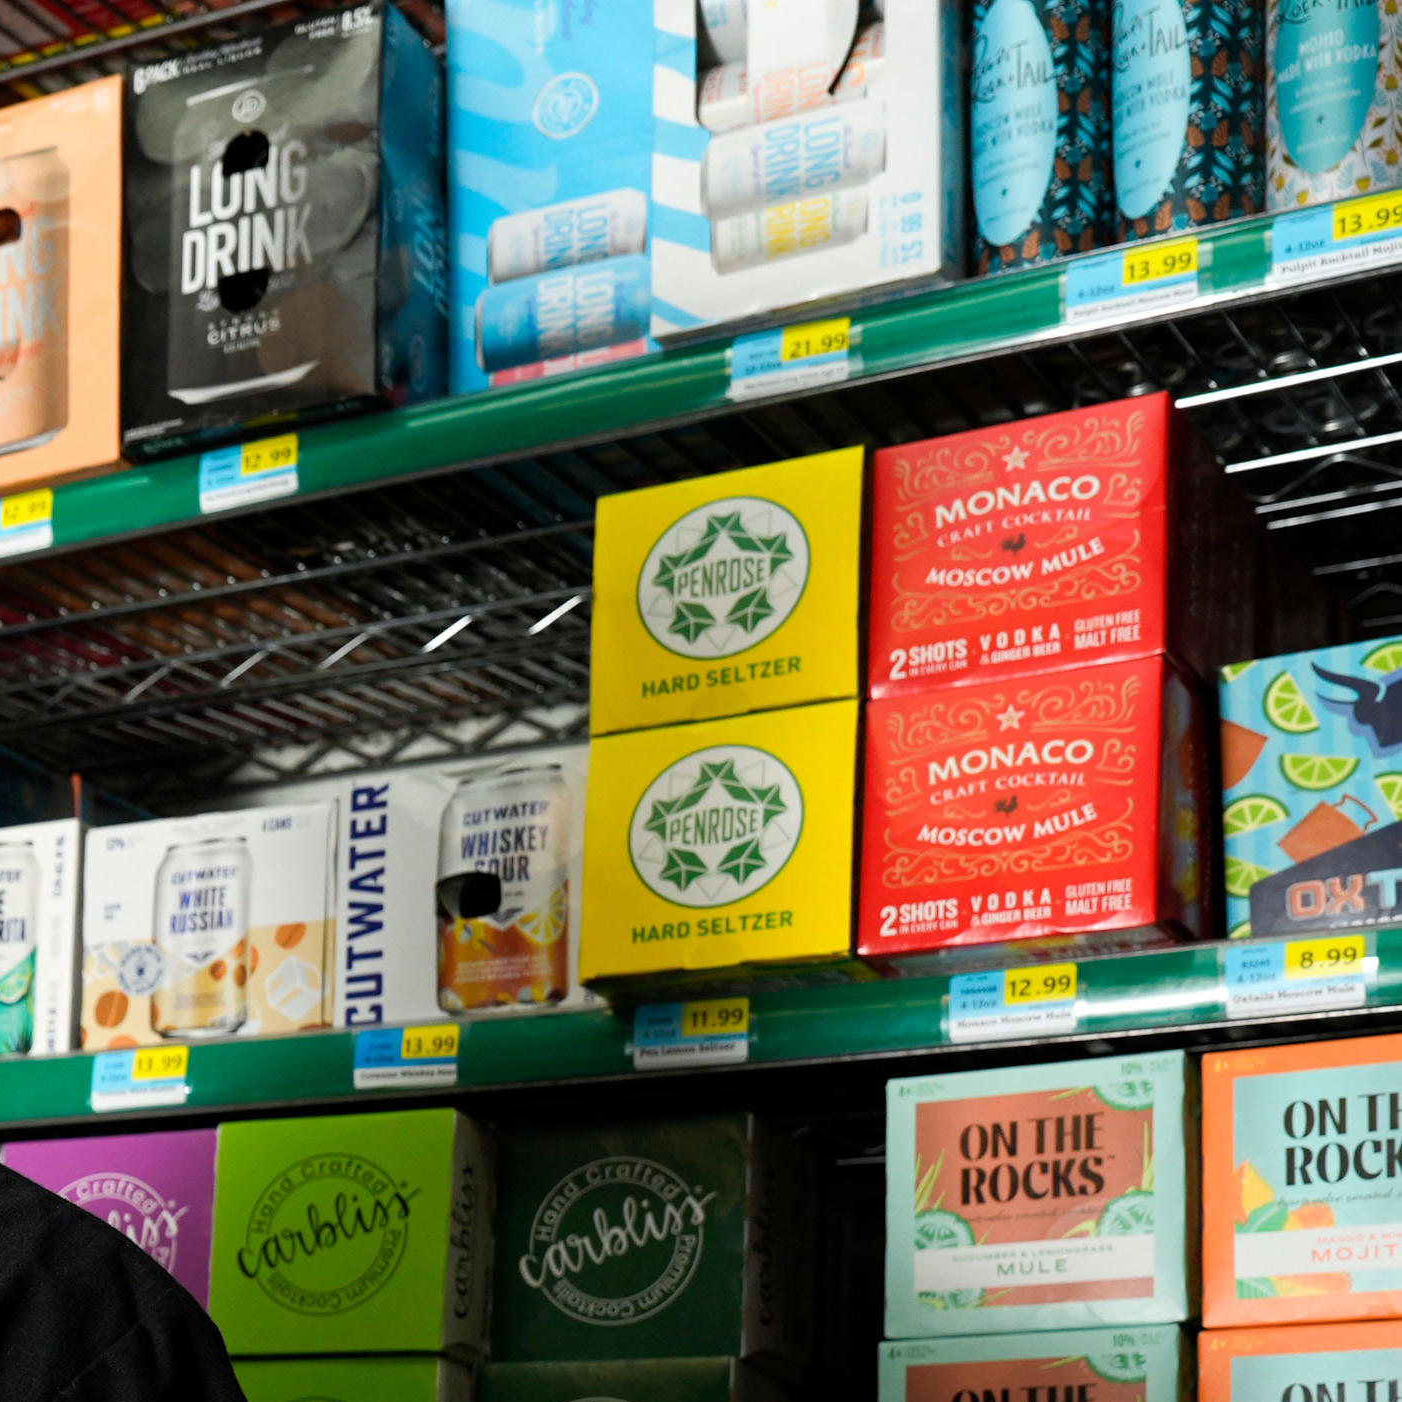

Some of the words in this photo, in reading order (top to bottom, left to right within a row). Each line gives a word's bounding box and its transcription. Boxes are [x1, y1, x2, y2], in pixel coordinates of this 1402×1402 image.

[806, 116, 843, 190] LONG
[182, 206, 312, 294] DRINK
[1129, 252, 1191, 276] 13.99
[208, 316, 281, 346] CITRUS
[791, 333, 846, 359] 21.99
[933, 474, 1100, 529] MONACO
[937, 522, 994, 549] CRAFT
[1002, 506, 1092, 529] COCKTAIL
[677, 554, 766, 599] PENROSE
[926, 564, 1032, 588] MOSCOW
[1041, 537, 1105, 573] MULE
[1074, 615, 1110, 633] GLUTEN
[1113, 609, 1140, 625] FREE
[1074, 631, 1109, 649] MALT
[1111, 623, 1140, 643] FREE
[642, 675, 700, 699] HARD
[706, 656, 802, 684] SELTZER
[889, 650, 908, 679] 2
[909, 638, 967, 665] SHOTS
[927, 739, 1093, 787] MONACO
[931, 782, 987, 805] CRAFT
[995, 769, 1087, 789] COCKTAIL
[461, 825, 548, 860] WHISKEY
[667, 805, 759, 844] PENROSE
[917, 822, 1022, 847] MOSCOW
[1033, 802, 1098, 838] MULE
[179, 886, 226, 910] WHITE
[346, 783, 391, 1025] CUTWATER
[880, 908, 897, 936] 2
[900, 899, 957, 923] SHOTS
[170, 908, 234, 935] RUSSIAN
[632, 922, 690, 944] HARD
[696, 910, 793, 933] SELTZER
[1301, 947, 1358, 968] 8.99
[1010, 977, 1071, 998] 12.99
[690, 1010, 745, 1029] 11.99
[406, 1035, 454, 1053] 13.99
[960, 1121, 1018, 1163] ON
[1028, 1112, 1105, 1154] THE
[1284, 1097, 1346, 1140] ON
[254, 1176, 296, 1235] Hand
[300, 1156, 390, 1195] Crafted
[534, 1179, 578, 1242] Hand
[587, 1161, 682, 1200] Crafted
[961, 1156, 1105, 1206] ROCKS
[238, 1181, 421, 1279] carbliss
[518, 1186, 716, 1289] carbliss
[996, 1260, 1067, 1277] MULE
